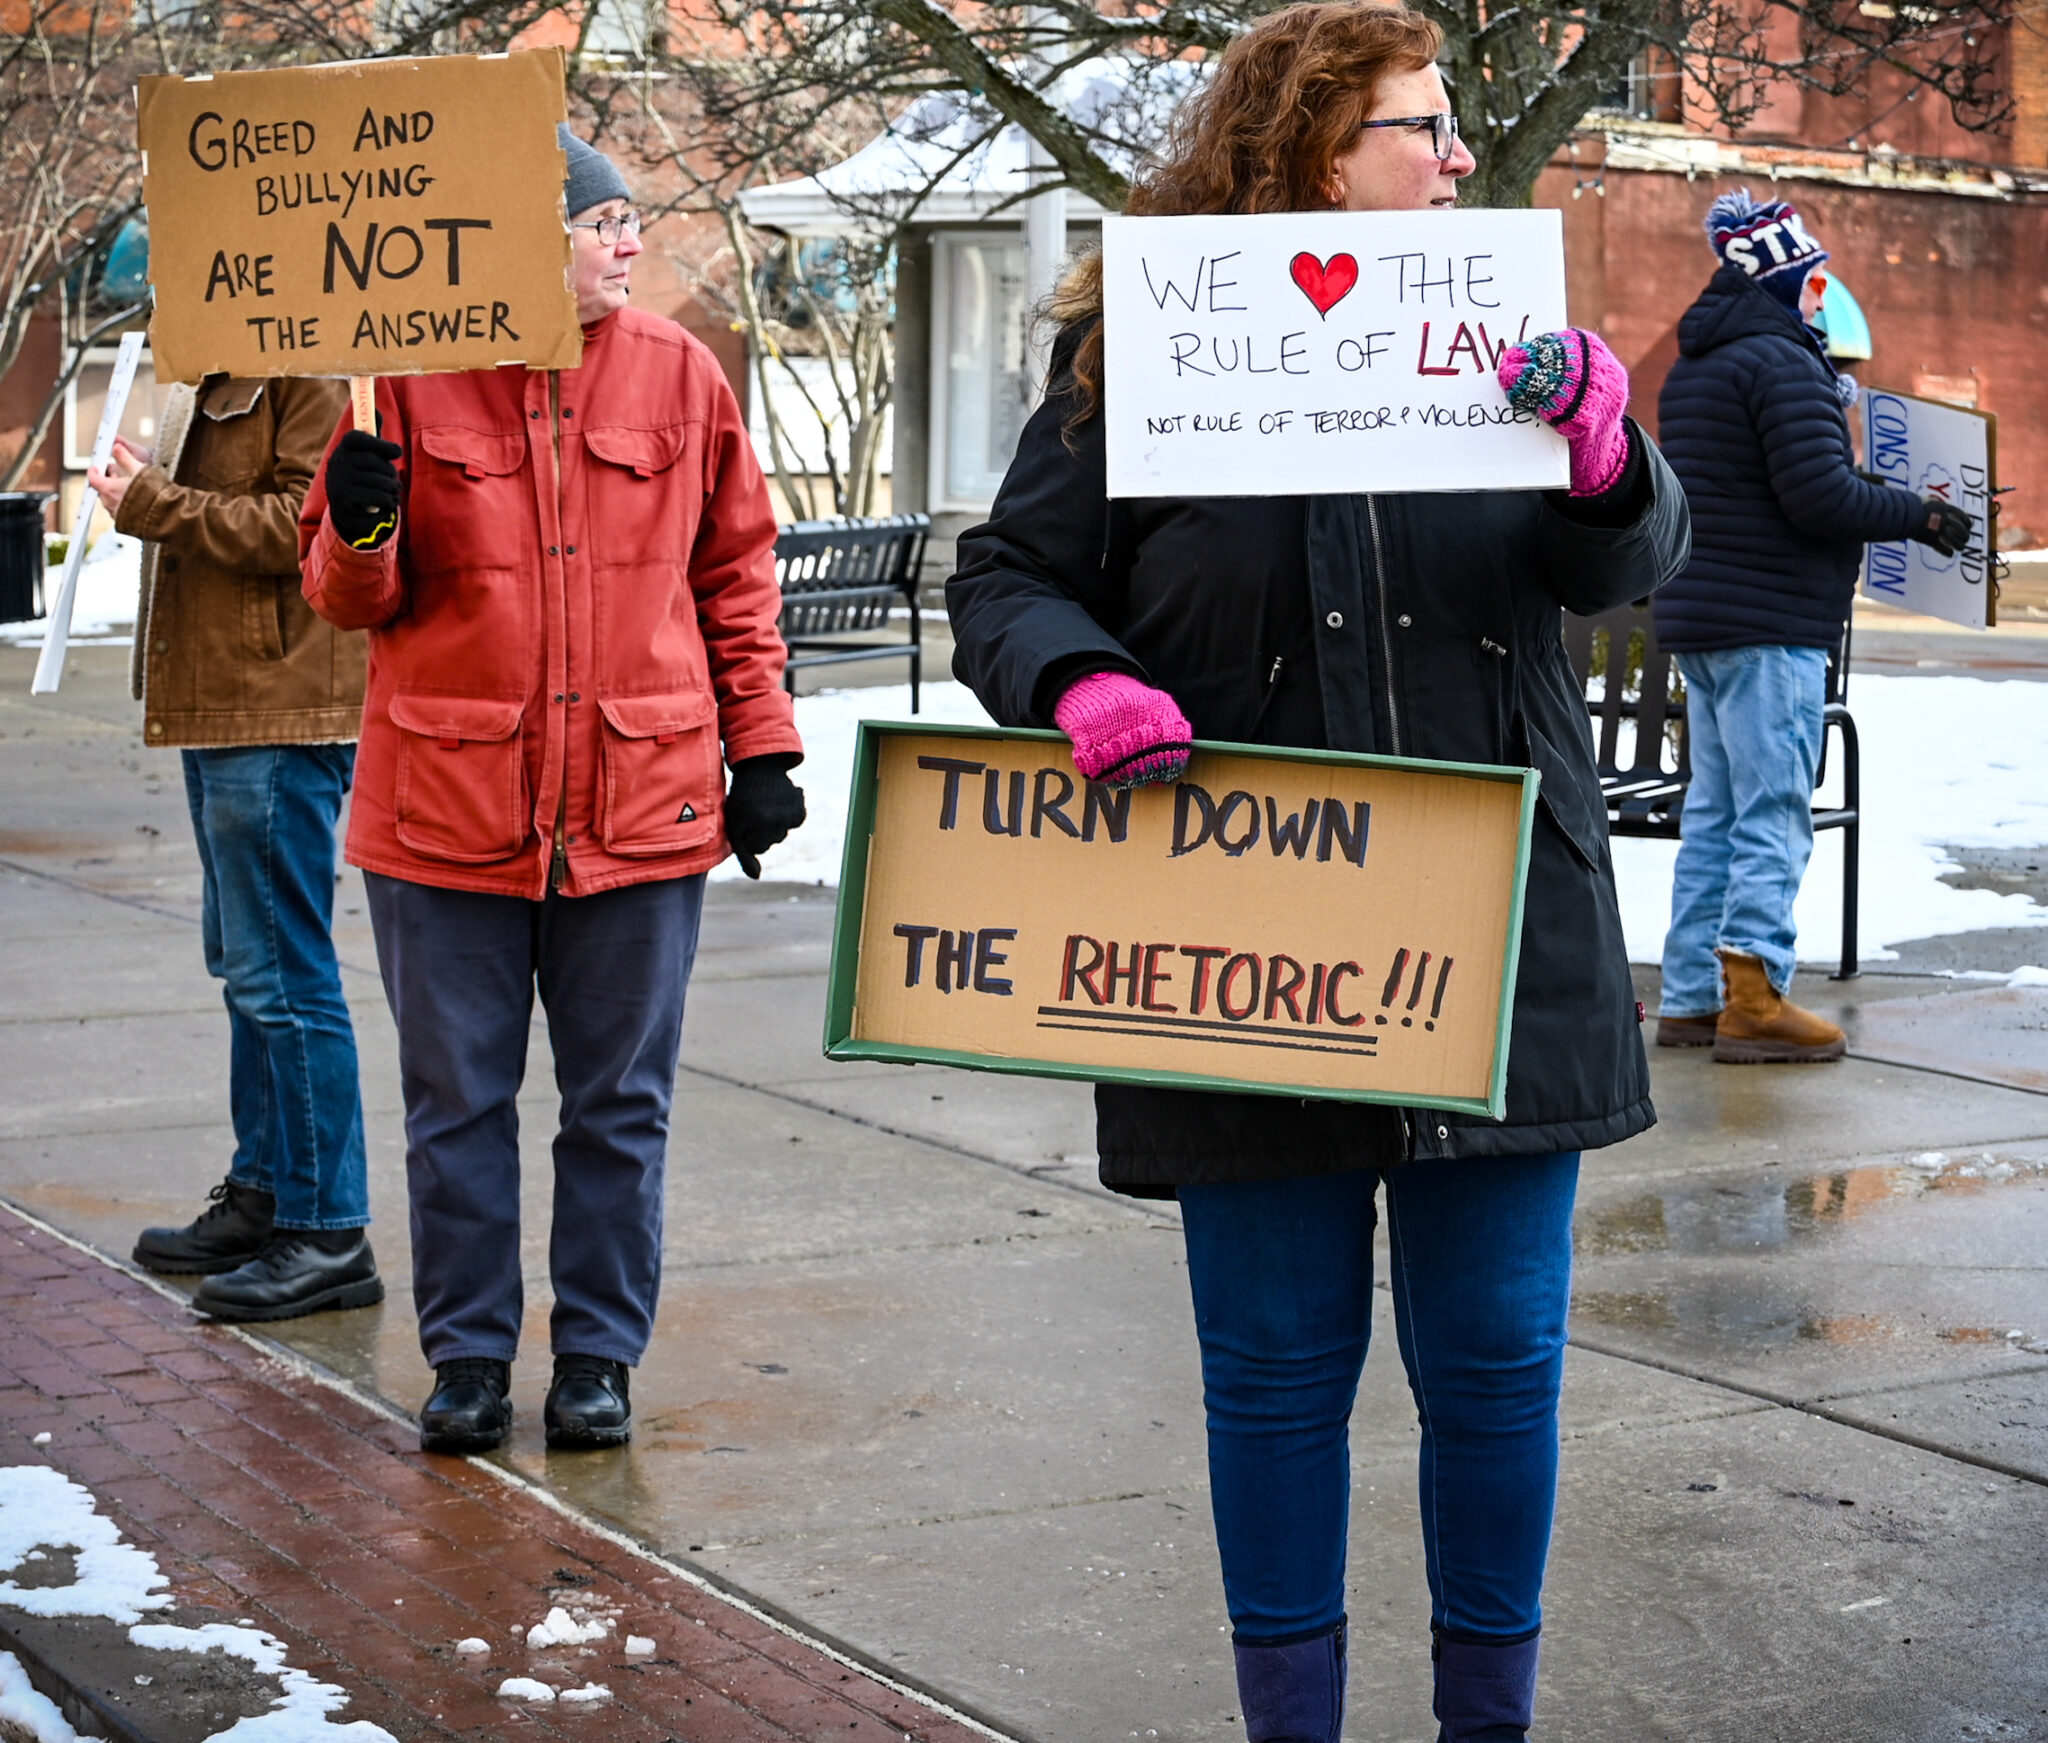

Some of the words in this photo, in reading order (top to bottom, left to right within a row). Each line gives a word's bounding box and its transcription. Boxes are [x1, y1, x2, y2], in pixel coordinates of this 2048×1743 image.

[189, 111, 315, 171] GREED
[353, 107, 434, 152] AND
[256, 164, 436, 218] BULLYING
[205, 250, 275, 302] ARE
[323, 218, 492, 294] NOT
[1142, 251, 1248, 313] WE
[1377, 253, 1501, 308] THE
[246, 316, 320, 353] THE
[351, 301, 520, 350] ANSWER
[1170, 331, 1310, 377] RULE
[1336, 331, 1396, 372] OF
[1417, 314, 1529, 376] LAW
[1147, 414, 1185, 435] NOT
[1194, 411, 1243, 433] RULE
[1259, 411, 1294, 435] OF
[1304, 407, 1397, 434] TERROR
[917, 755, 1132, 843] TURN
[1167, 782, 1371, 868] DOWN
[893, 923, 1018, 996] THE
[1059, 934, 1454, 1032] RHETORIC!!!
